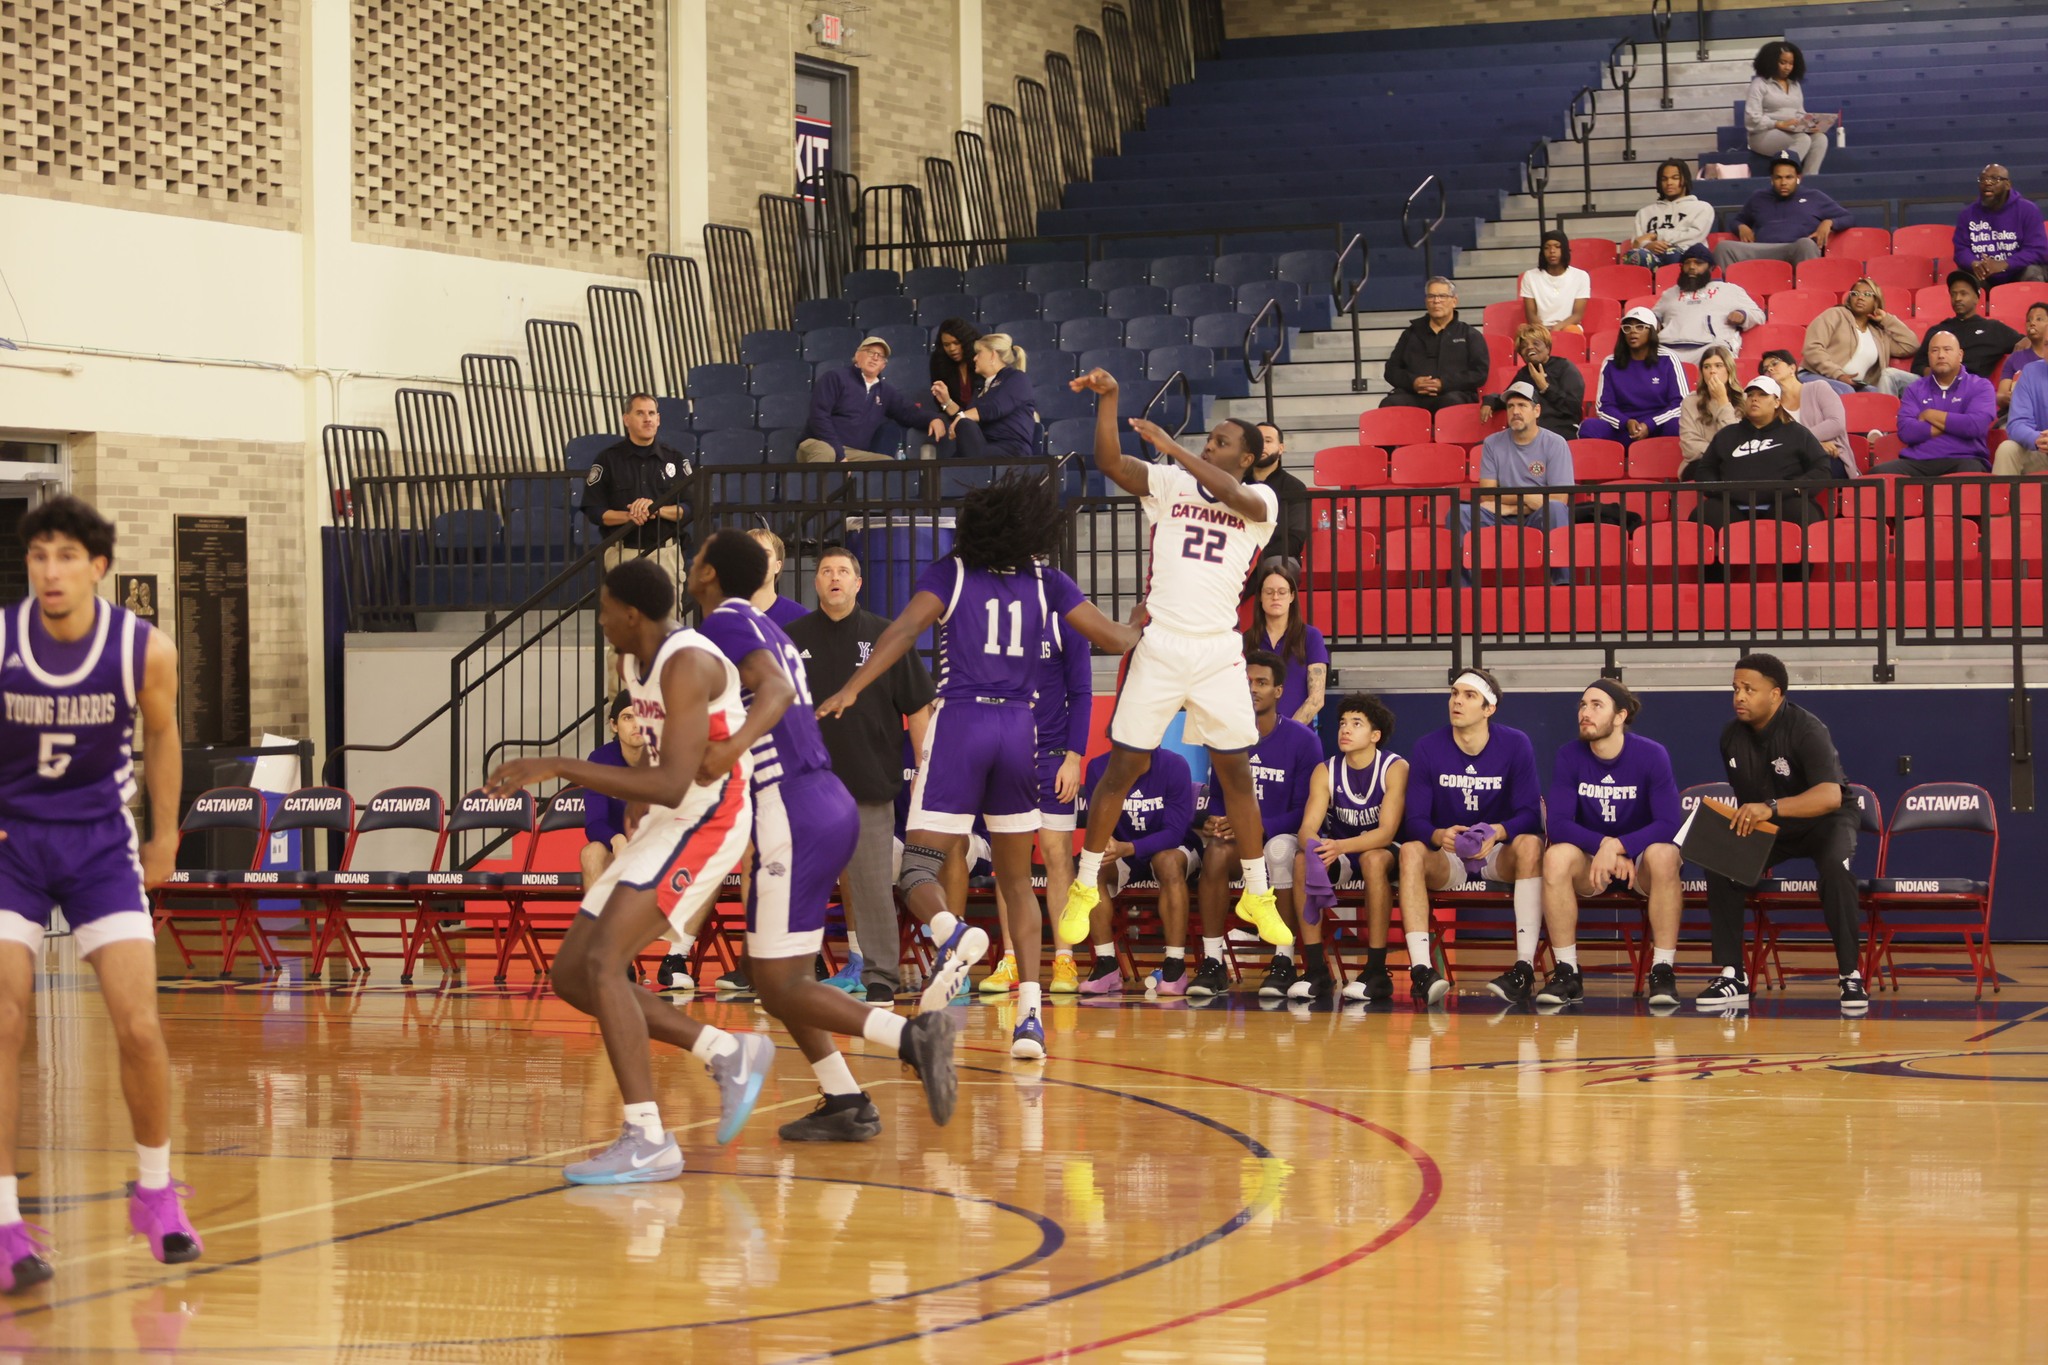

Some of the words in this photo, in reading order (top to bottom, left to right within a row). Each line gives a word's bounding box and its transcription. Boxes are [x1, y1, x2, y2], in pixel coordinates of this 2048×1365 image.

[1171, 503, 1246, 532] CATAWBA
[1182, 525, 1227, 564] 22
[984, 598, 1024, 657] 11
[4, 691, 54, 725] YOUNG
[57, 692, 116, 725] HARRIS
[37, 732, 76, 778] 5
[1439, 774, 1502, 790] COMPETE
[1578, 782, 1637, 799] COMPETE
[196, 798, 253, 812] CATAWBA
[284, 797, 342, 811] CATAWBA
[372, 797, 431, 812] CATAWBA
[462, 797, 523, 812] CATAWBA
[554, 798, 585, 812] CATA
[1122, 797, 1164, 812] MPETE
[1906, 795, 1980, 811] CATAWBA
[244, 872, 278, 883] INDIANS
[334, 873, 370, 884] INDIANS
[427, 873, 463, 884] INDIANS
[522, 874, 559, 885] INDIANS
[1781, 881, 1818, 892] INDIAN
[1895, 881, 1939, 892] INDIANS
